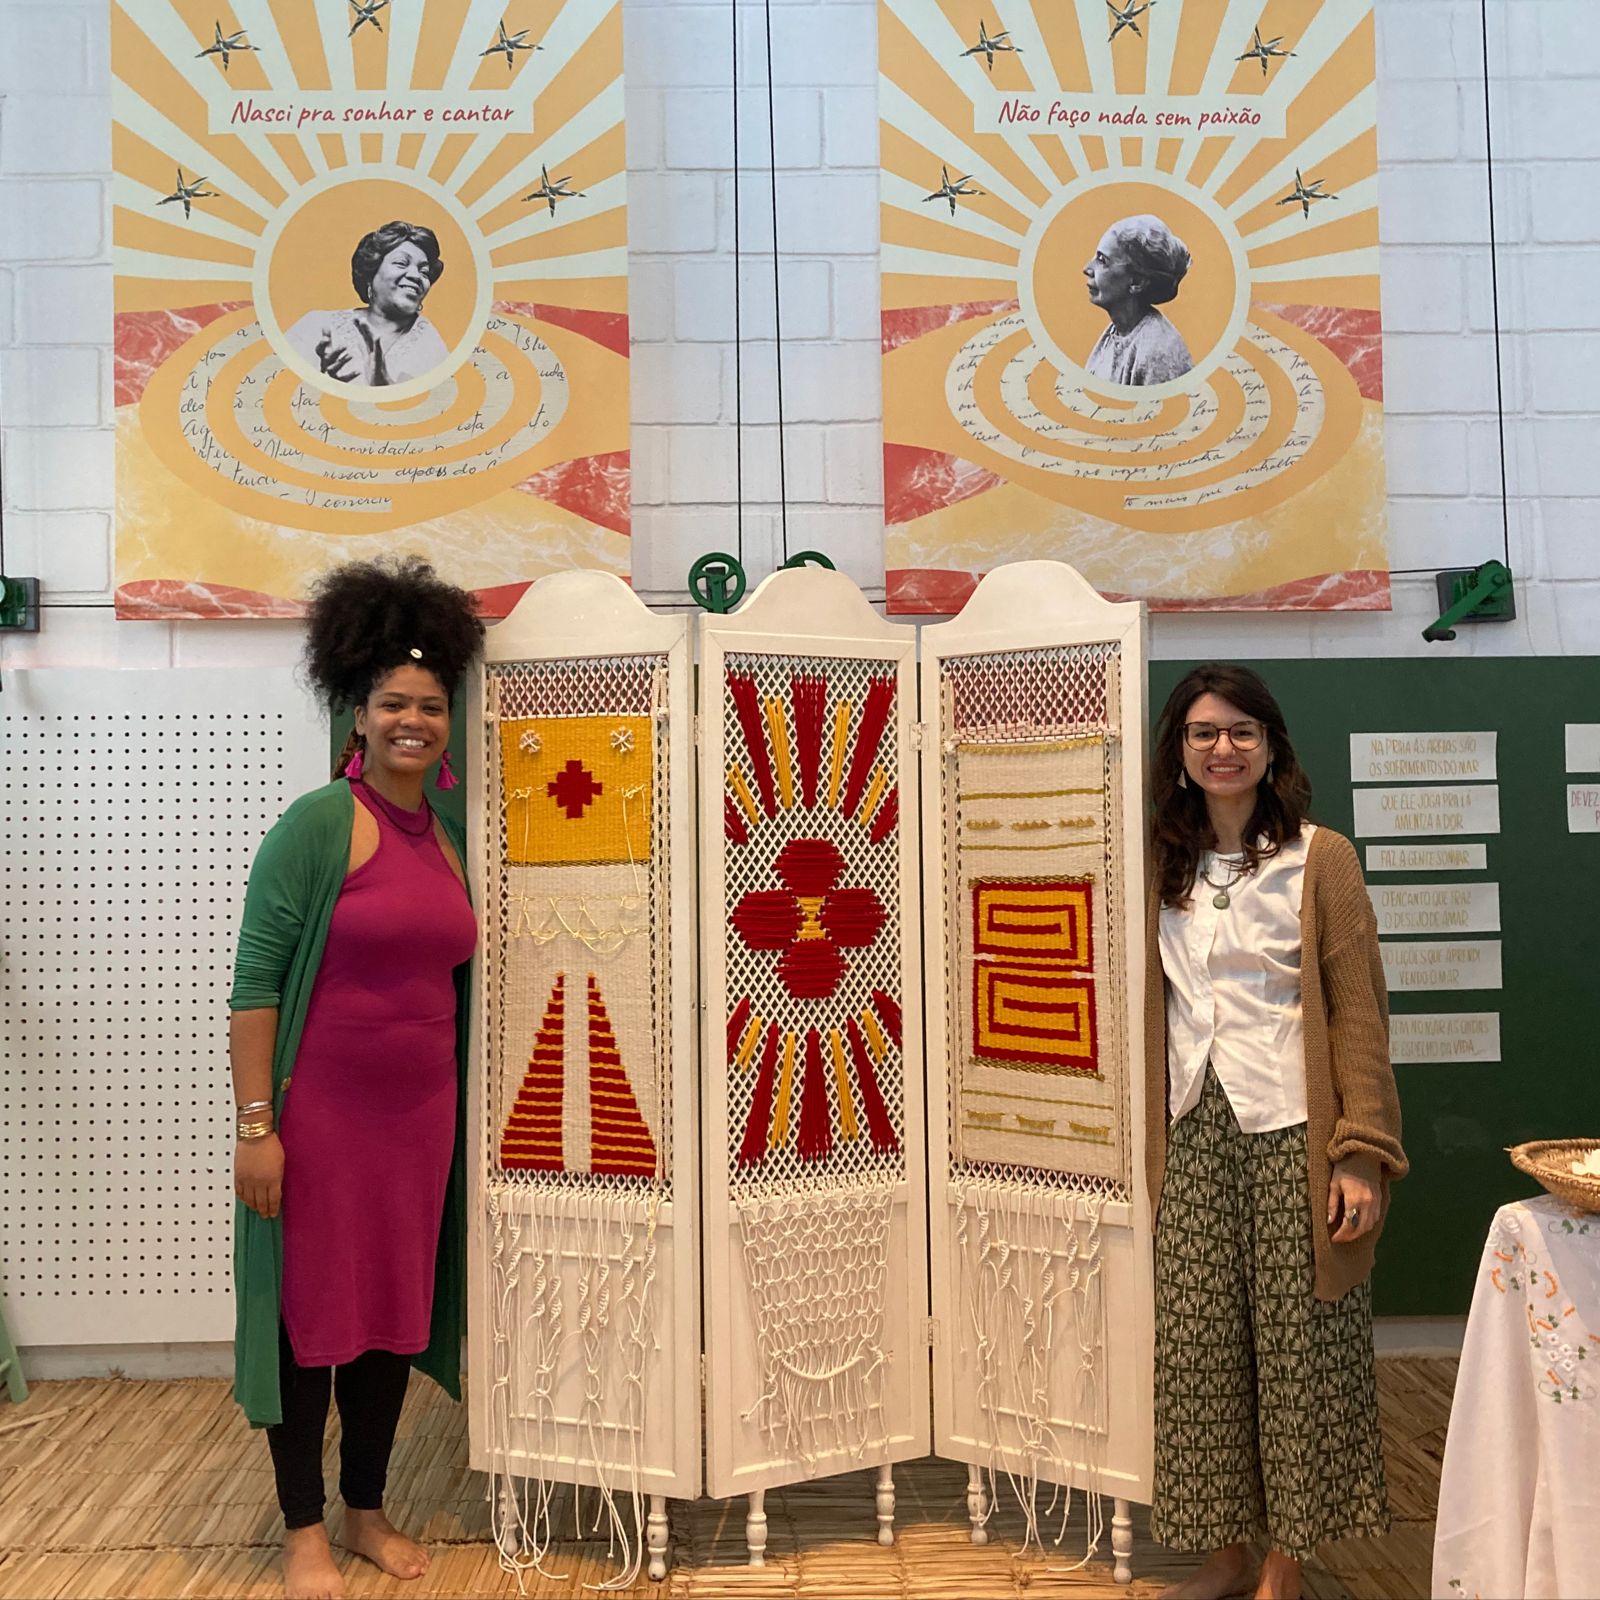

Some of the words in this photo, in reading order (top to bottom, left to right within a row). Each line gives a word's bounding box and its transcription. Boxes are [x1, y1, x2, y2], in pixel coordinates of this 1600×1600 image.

[231, 99, 293, 124] Nasci
[297, 108, 335, 128] pra
[343, 101, 417, 122] sonhar
[423, 108, 434, 122] e
[442, 105, 514, 122] cantar
[998, 99, 1040, 124] Não
[1048, 101, 1090, 128] faço
[1098, 105, 1148, 125] nada
[1155, 111, 1192, 125] sem
[1198, 107, 1261, 130] paixão
[1369, 762, 1382, 777] OS
[1384, 760, 1443, 776] SOFRIMENTOS
[1444, 760, 1457, 775] DO
[1381, 793, 1398, 811] QUE
[1400, 793, 1416, 810] ELE
[1418, 793, 1441, 810] JOGA
[1435, 814, 1442, 829] A
[1443, 814, 1464, 830] DOR
[1380, 850, 1396, 868] FAZ
[1408, 850, 1434, 866] GENTE
[1382, 891, 1390, 907] O
[1391, 890, 1430, 907] ENCANTO
[1399, 971, 1428, 985] VENDO
